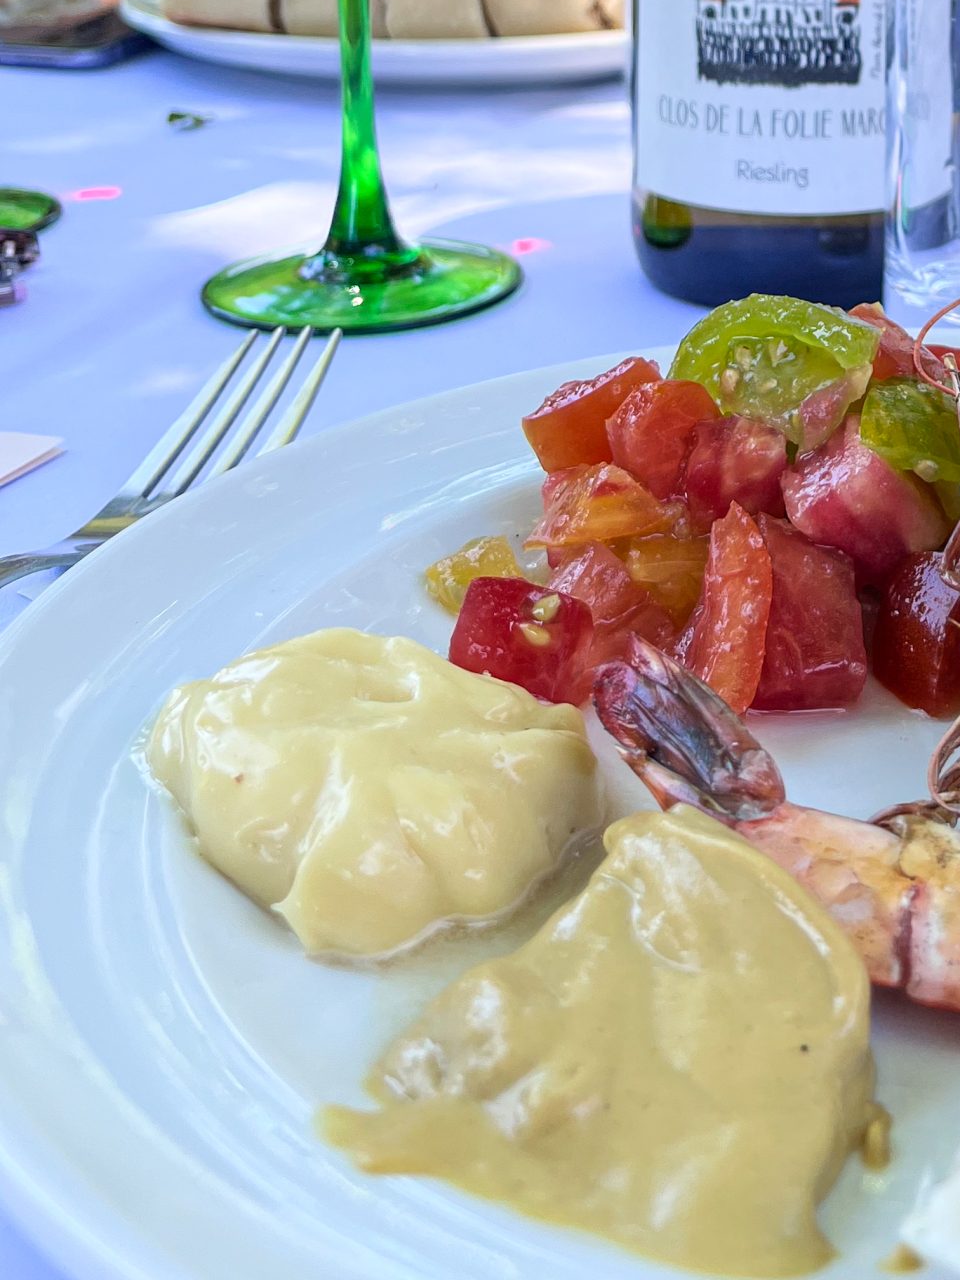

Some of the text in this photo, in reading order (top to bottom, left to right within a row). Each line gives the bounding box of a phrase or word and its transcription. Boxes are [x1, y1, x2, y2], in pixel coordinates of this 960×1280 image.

[658, 94, 699, 129] CLOS
[705, 103, 730, 134] DE
[738, 107, 762, 136] LA
[770, 109, 832, 138] FOLIE
[736, 158, 809, 188] Riesling
